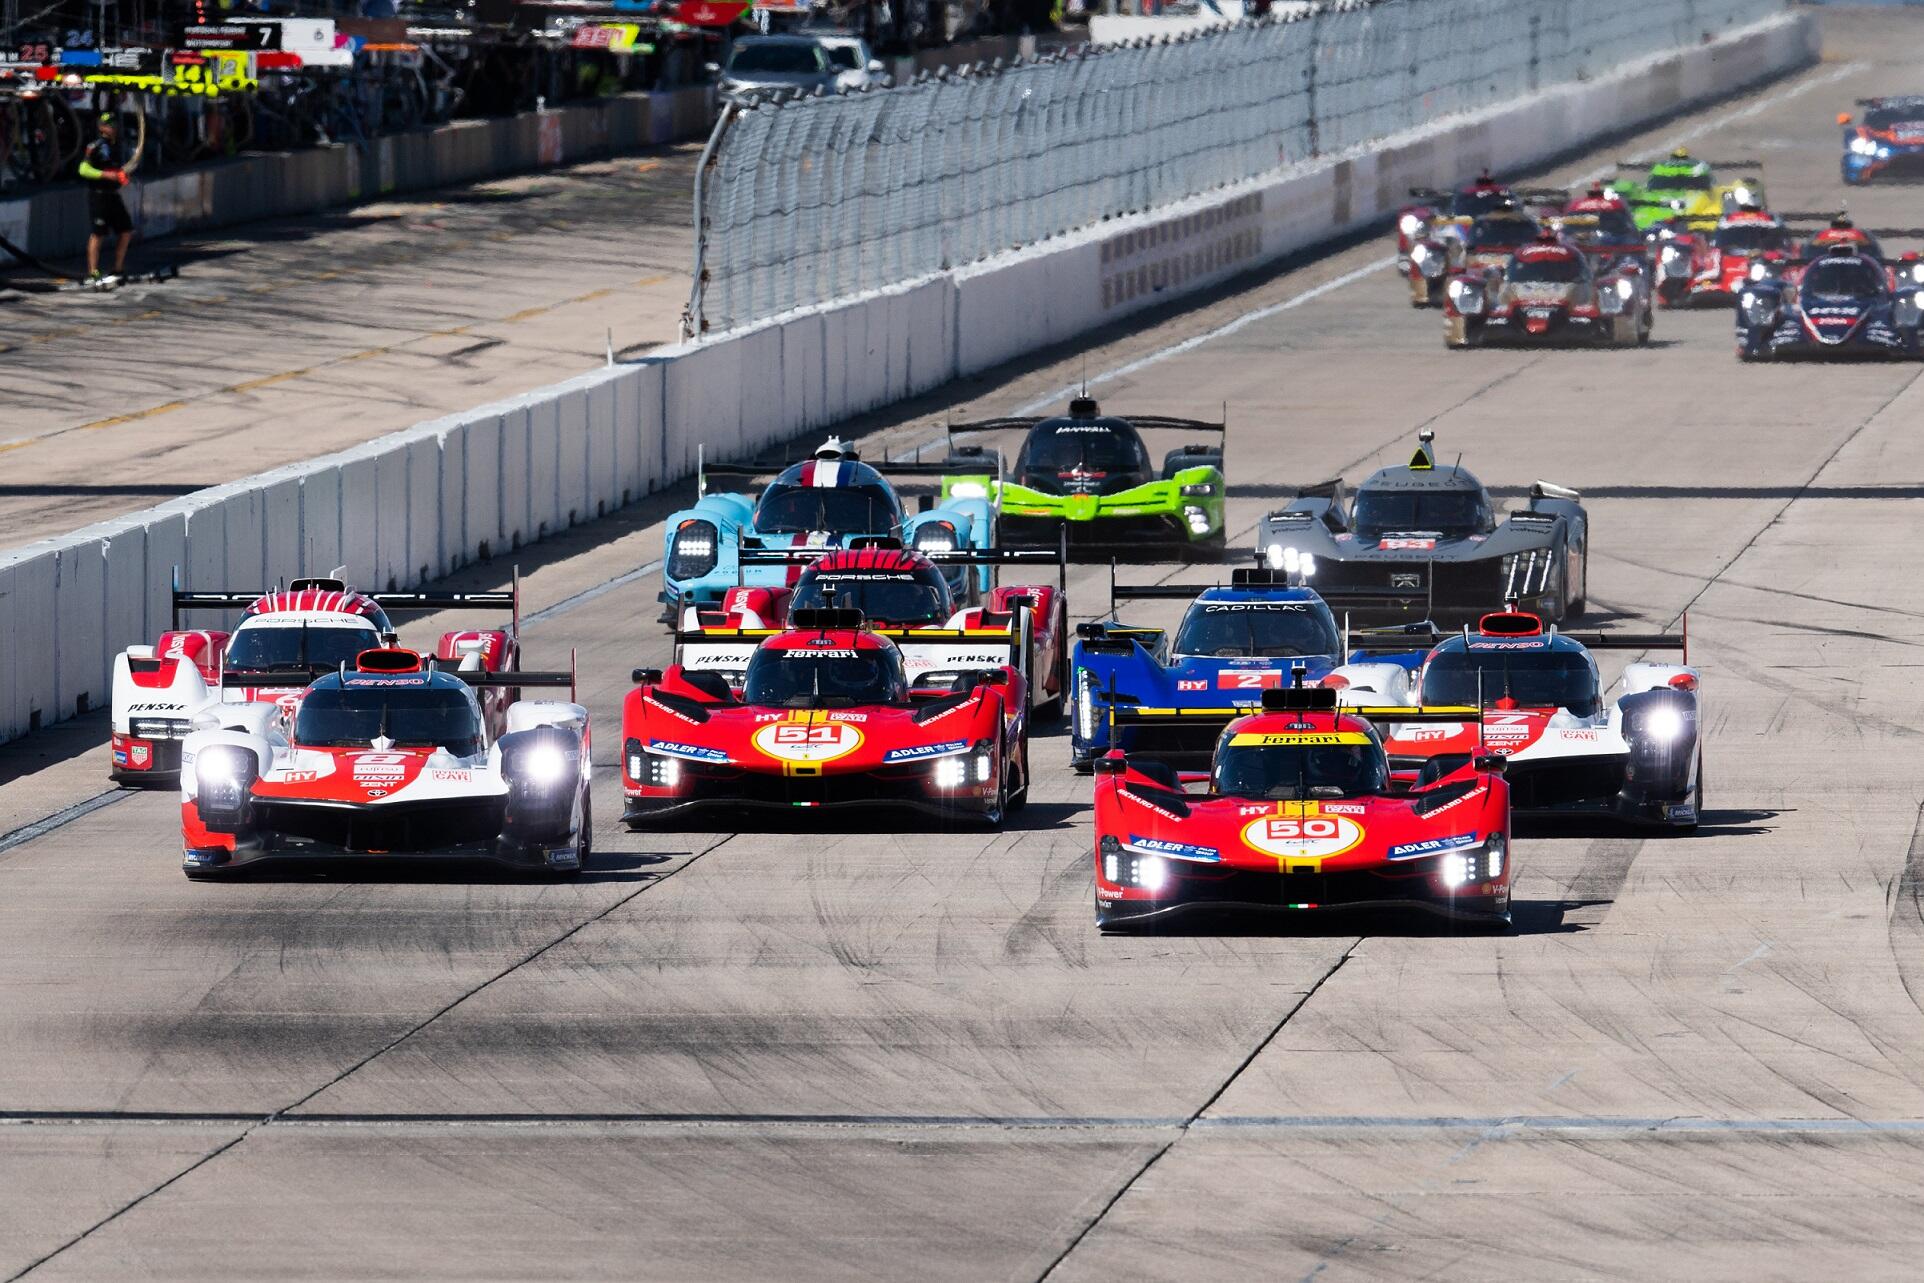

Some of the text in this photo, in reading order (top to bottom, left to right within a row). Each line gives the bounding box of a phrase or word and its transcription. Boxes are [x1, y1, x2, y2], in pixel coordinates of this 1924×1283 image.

[258, 27, 272, 46] 7
[815, 573, 915, 581] PORSCHE
[1205, 604, 1307, 613] CADILLAC
[1467, 641, 1545, 650] DENSO
[782, 649, 859, 659] Ferrari
[947, 654, 1005, 664] PENSKE
[344, 678, 425, 686] DENSO
[1179, 680, 1206, 690] HY
[1236, 674, 1263, 688] 2
[642, 695, 701, 727] RICHARD MILLE
[918, 696, 981, 728] RICHARD MILLE
[754, 713, 783, 722] HY
[777, 726, 839, 743] 51
[1261, 735, 1342, 744] Ferrari
[1415, 731, 1446, 741] HY
[652, 741, 698, 754] ADLER
[890, 746, 936, 758] ADLER
[353, 754, 407, 765] 8
[286, 771, 316, 782] HY
[434, 773, 470, 782] CAR
[1116, 788, 1183, 823] RICHARD MILLE
[1420, 785, 1489, 820] RICHARD MILLE
[1239, 805, 1271, 816] HY
[1270, 820, 1337, 838] 50
[1133, 838, 1184, 852] ADLER
[1394, 839, 1442, 855] ADLER
